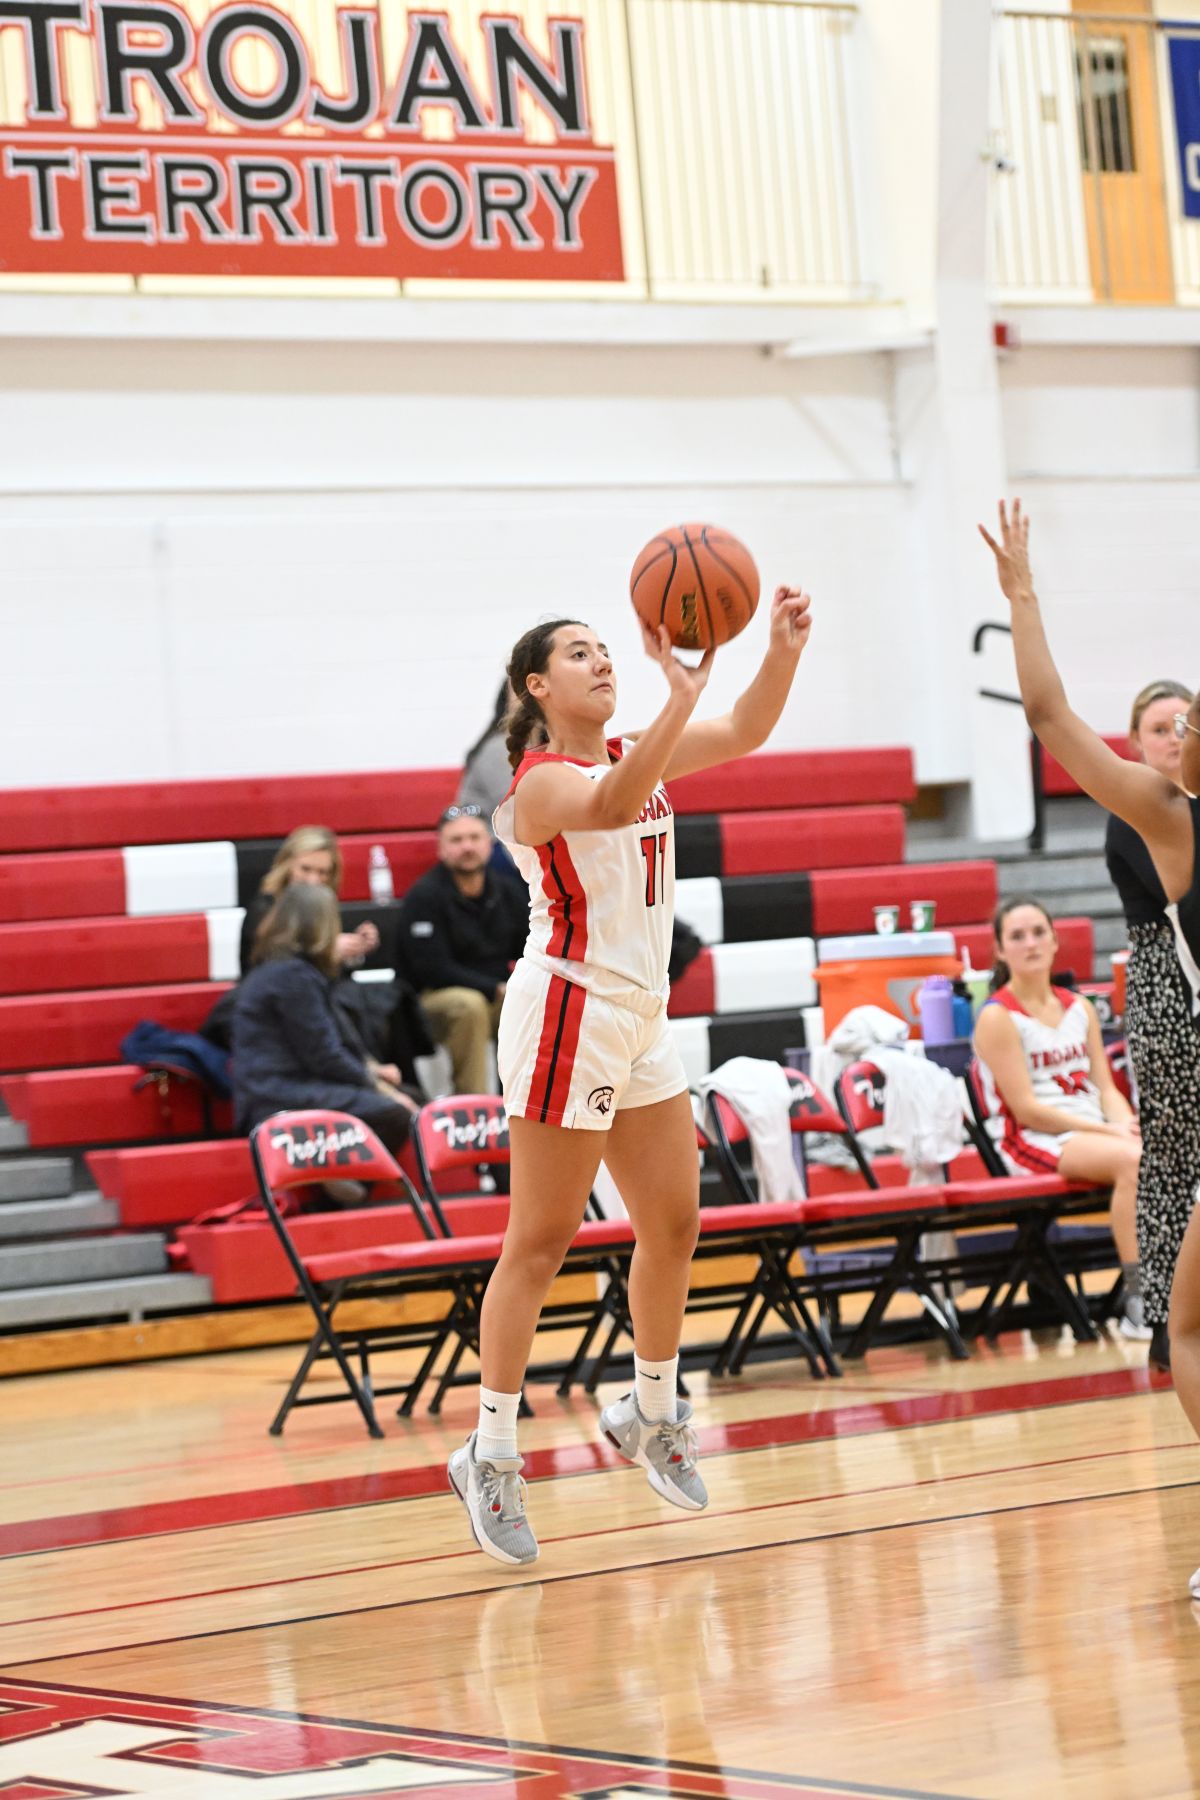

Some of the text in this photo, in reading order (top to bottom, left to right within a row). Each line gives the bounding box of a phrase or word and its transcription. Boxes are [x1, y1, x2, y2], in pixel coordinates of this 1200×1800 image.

[0, 0, 592, 138] TROJAN
[5, 148, 598, 250] TERRITORY
[640, 832, 667, 907] 11
[270, 1124, 368, 1165] Trojans
